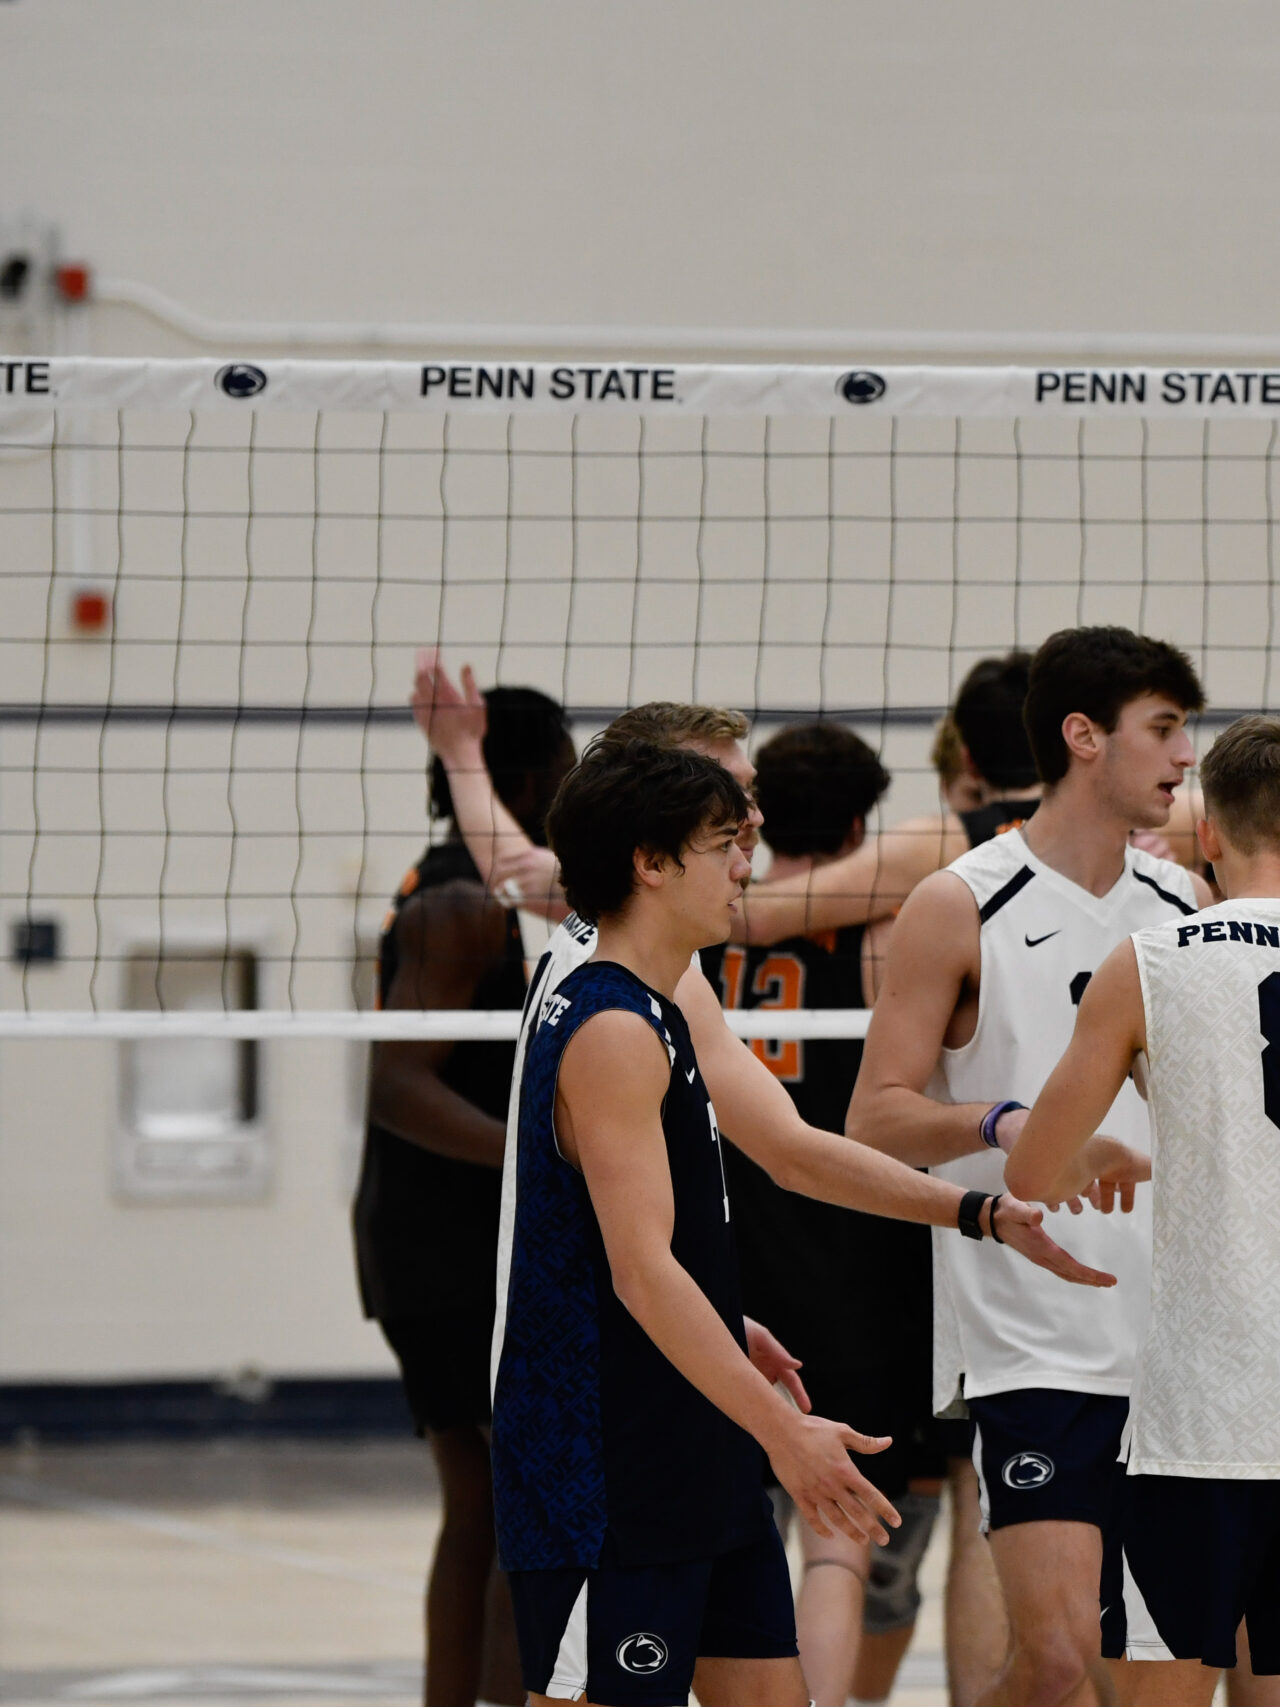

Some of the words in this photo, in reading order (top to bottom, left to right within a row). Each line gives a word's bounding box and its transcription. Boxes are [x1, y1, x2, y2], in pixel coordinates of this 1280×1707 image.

[420, 366, 535, 399] PENN
[549, 368, 675, 401] STATE
[1035, 372, 1146, 404] PENN
[1176, 920, 1280, 949] PENN
